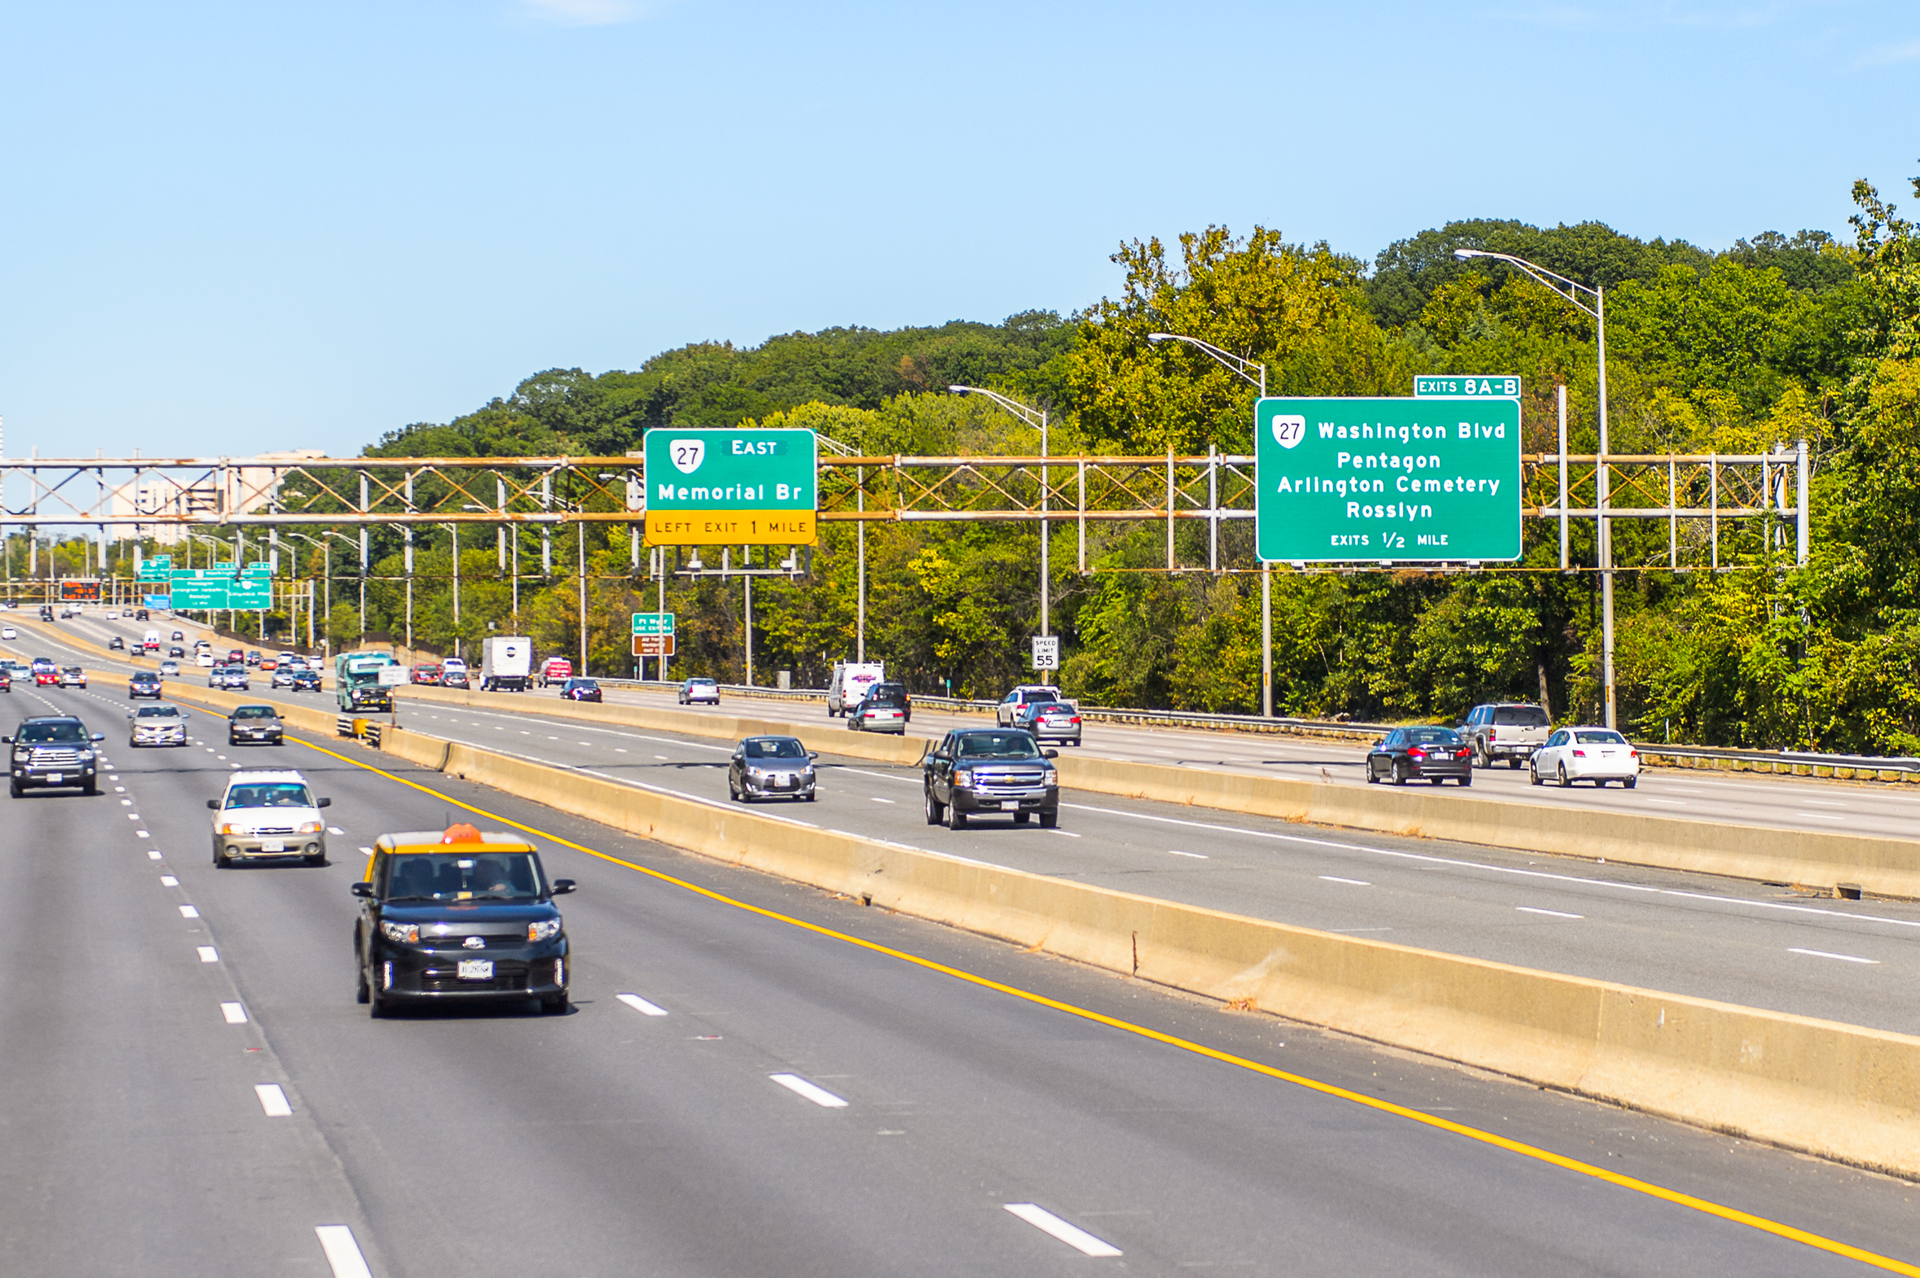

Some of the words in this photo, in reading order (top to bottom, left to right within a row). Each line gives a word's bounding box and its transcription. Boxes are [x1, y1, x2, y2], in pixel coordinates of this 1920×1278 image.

[1419, 381, 1457, 392] EXITS
[1464, 379, 1517, 395] 8A-B
[1280, 422, 1300, 440] 27
[1318, 422, 1447, 444] Washington
[1458, 422, 1505, 439] Blvd
[731, 439, 777, 455] EAST
[677, 447, 699, 465] 27
[1337, 452, 1441, 473] Pentagon
[658, 483, 764, 500] Memorial
[776, 483, 802, 500] Br
[1277, 476, 1384, 497] Arlington
[1396, 476, 1500, 496] Cemetery
[1346, 501, 1433, 521] Rosslyn
[655, 522, 691, 533] LEFT
[705, 522, 738, 533] EXIT
[751, 520, 756, 535] 1
[769, 522, 807, 533] MILE
[1330, 534, 1370, 546] EXITS
[1417, 534, 1449, 546] MILE
[1037, 655, 1053, 666] 55
